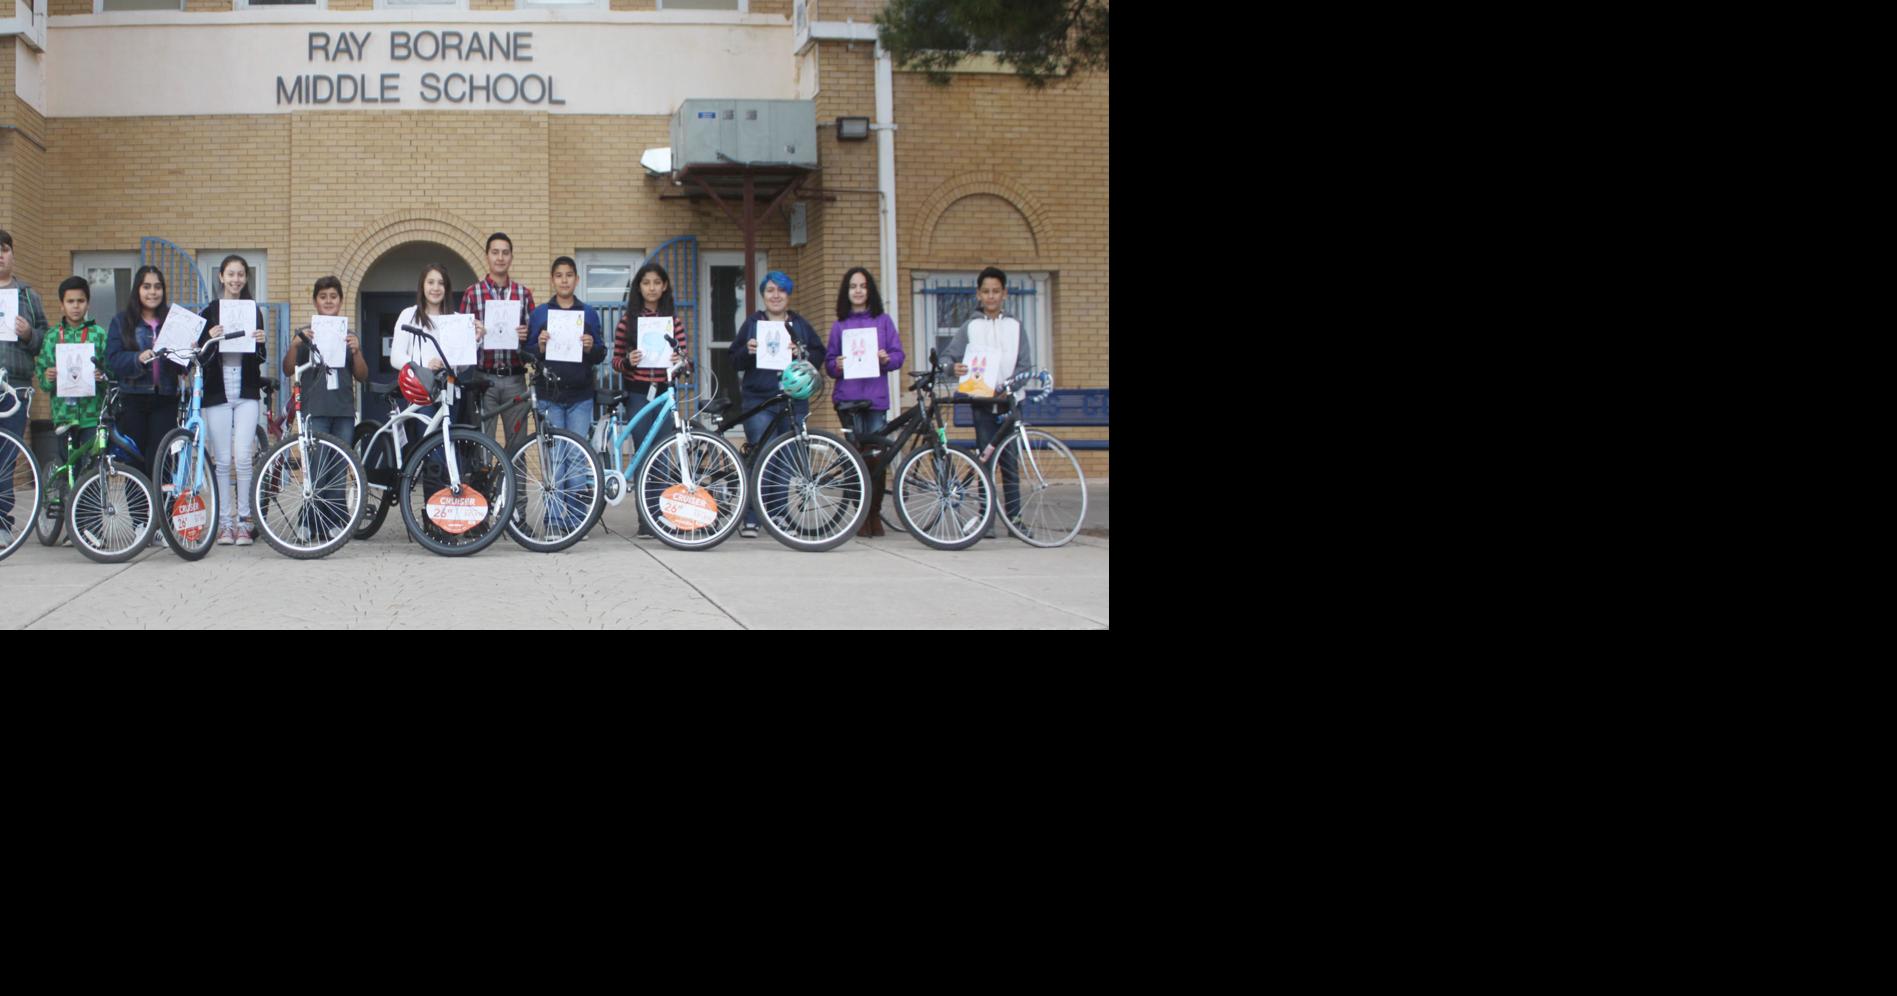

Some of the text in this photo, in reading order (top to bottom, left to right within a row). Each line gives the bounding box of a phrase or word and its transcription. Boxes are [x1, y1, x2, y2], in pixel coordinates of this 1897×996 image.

[308, 30, 533, 62] RAY BORANE
[276, 72, 566, 105] MIDDLE SCHOOL
[440, 496, 476, 505] CRUISER
[672, 492, 707, 507] CRUISER
[178, 502, 199, 513] CRUISER
